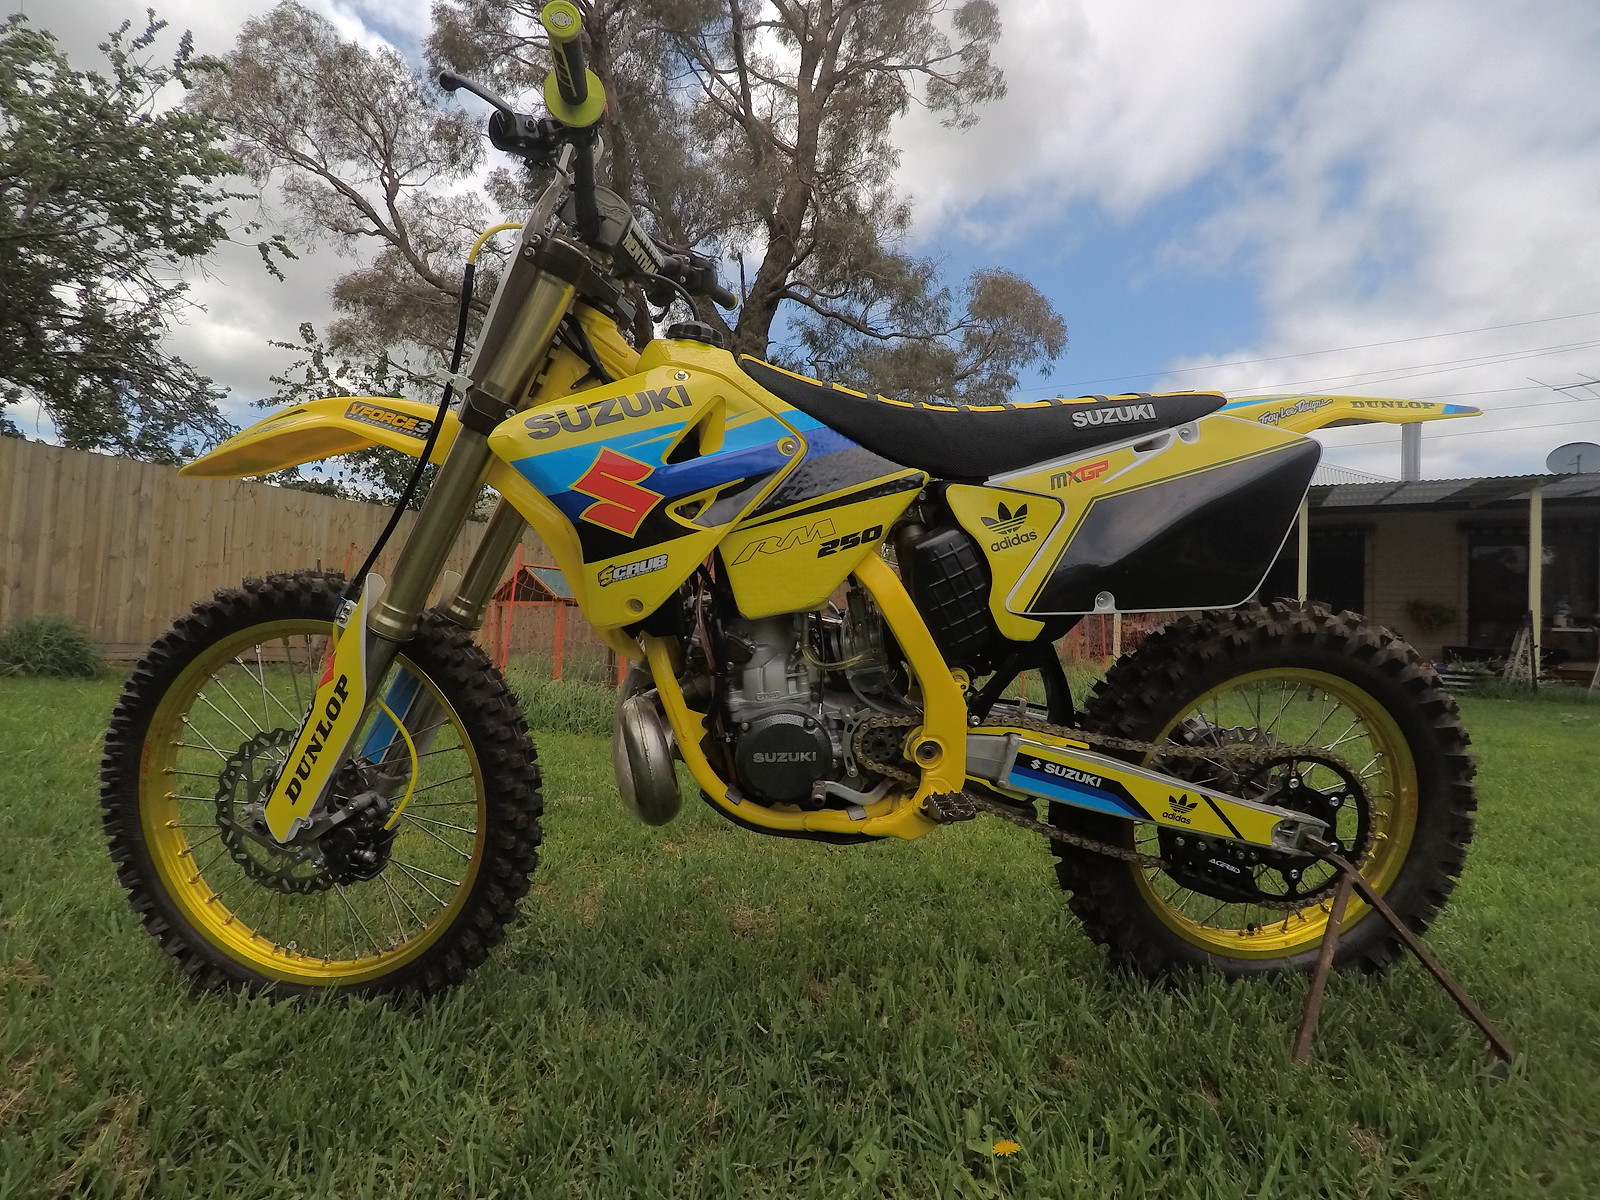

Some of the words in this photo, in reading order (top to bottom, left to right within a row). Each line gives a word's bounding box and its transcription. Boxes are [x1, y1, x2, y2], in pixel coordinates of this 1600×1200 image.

[523, 384, 693, 440] SUZUKI
[1071, 403, 1157, 429] SUZUKI
[1258, 410, 1280, 426] Troy
[1280, 405, 1297, 419] Lee
[1350, 400, 1436, 409] DUNLOP
[1050, 459, 1109, 491] MXGP
[731, 518, 837, 566] RM
[817, 524, 884, 559] 250
[990, 528, 1038, 552] adidas
[598, 554, 669, 587] SCRUB
[284, 673, 350, 806] DUNLOP
[752, 751, 817, 763] SUZUKI
[1044, 763, 1102, 788] SUZUKI
[1162, 810, 1192, 825] adidas
